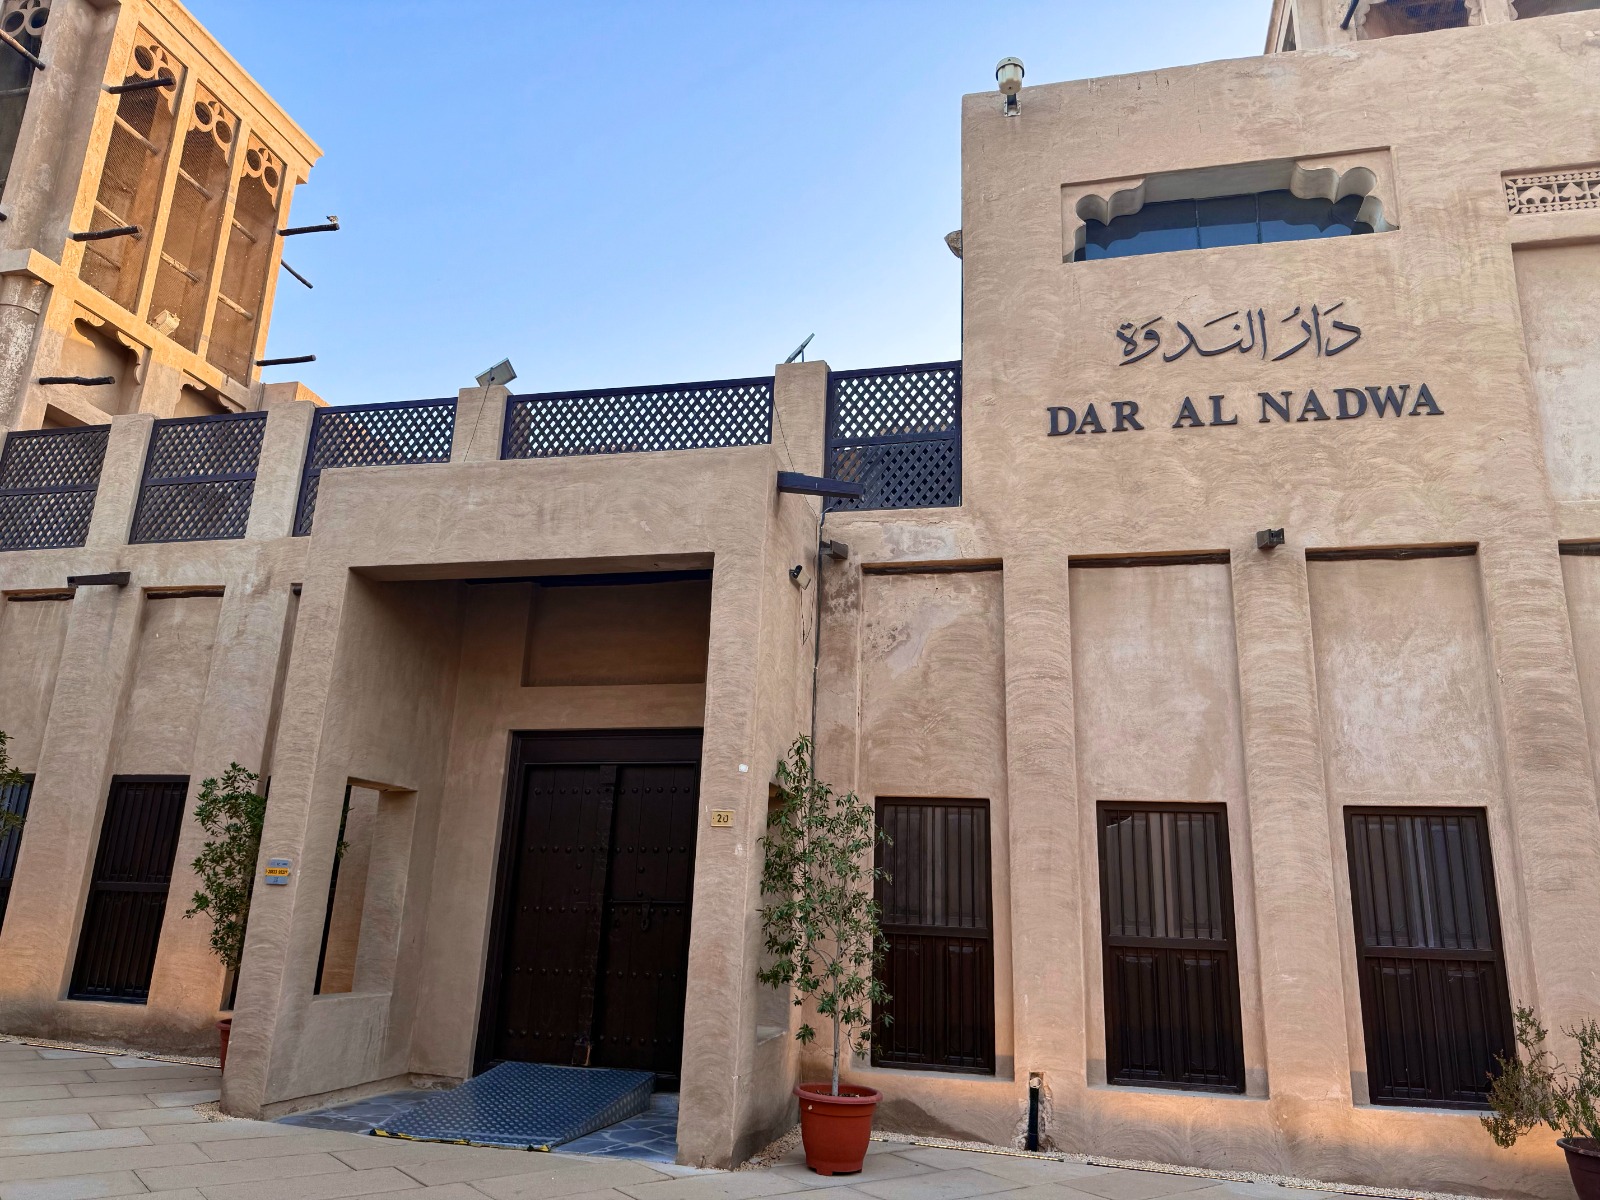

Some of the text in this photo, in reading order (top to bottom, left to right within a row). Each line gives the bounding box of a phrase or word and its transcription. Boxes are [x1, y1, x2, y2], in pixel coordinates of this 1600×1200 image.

[1047, 383, 1444, 436] DAR AL NADWA
[716, 813, 729, 823] 20
